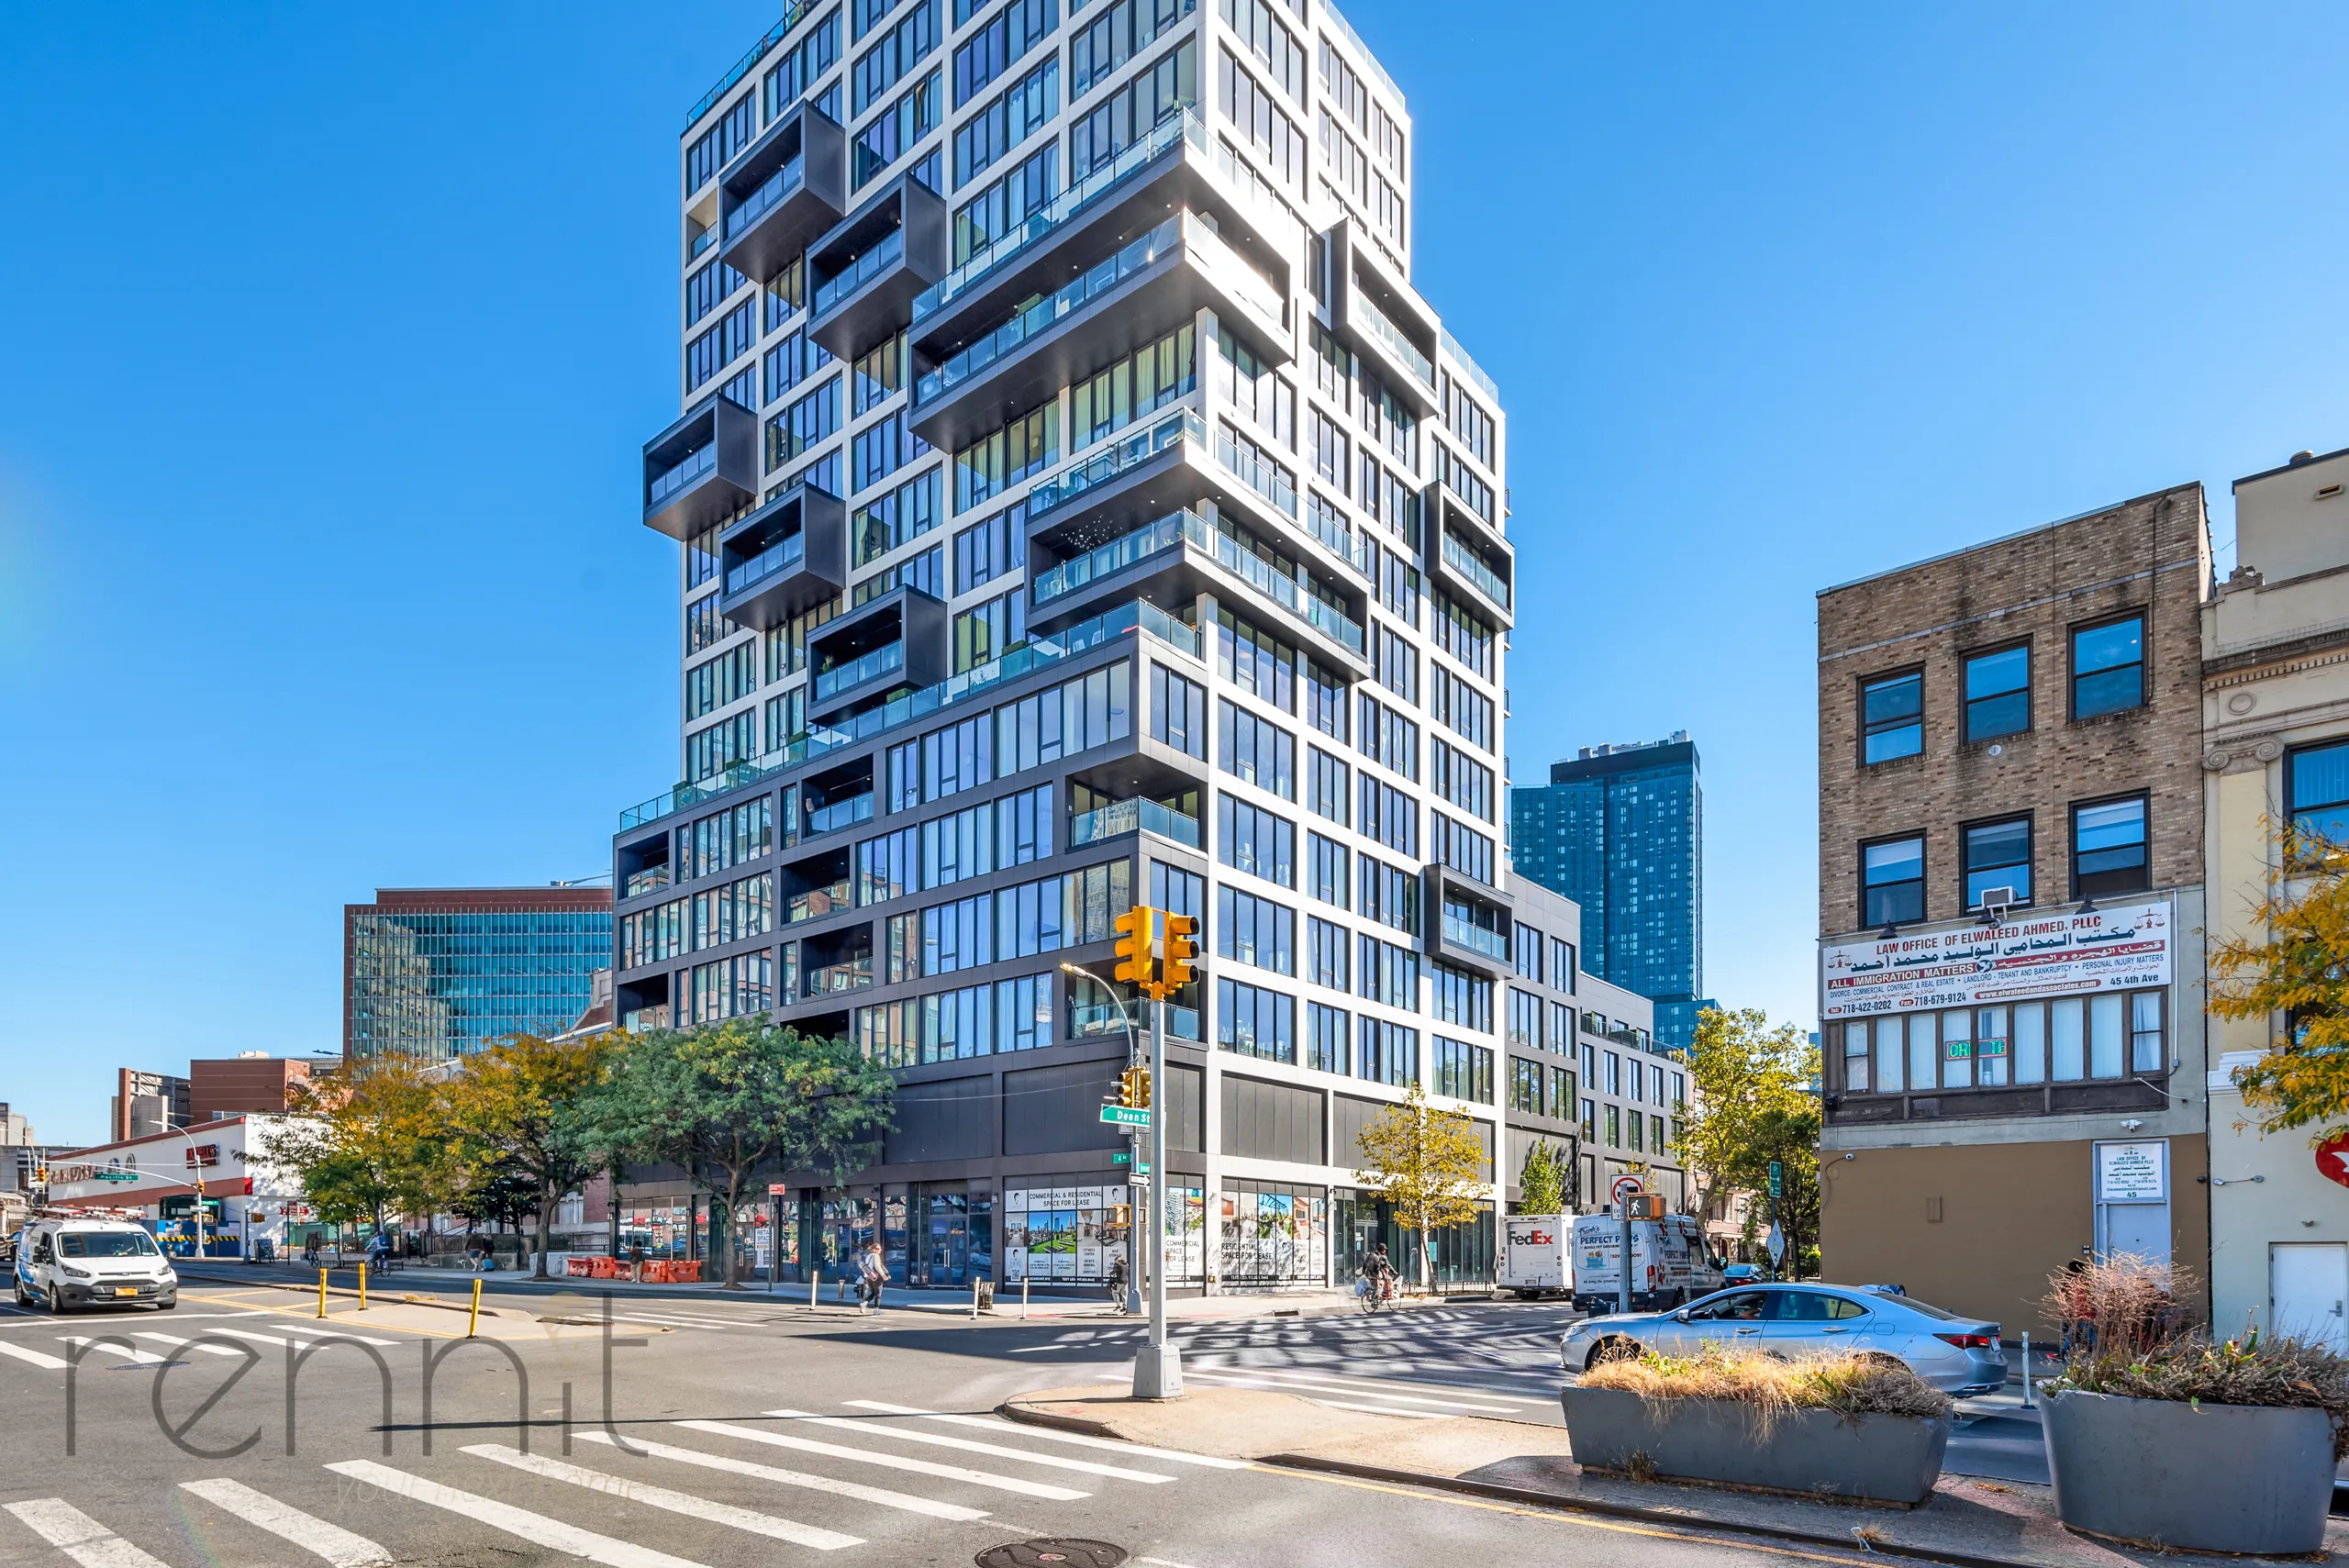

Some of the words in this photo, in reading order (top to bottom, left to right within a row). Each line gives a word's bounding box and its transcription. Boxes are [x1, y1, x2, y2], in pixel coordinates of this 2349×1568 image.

[1876, 943, 1898, 955] LAW
[1902, 938, 1938, 953] OFFICE
[1944, 934, 1957, 946] OF
[1961, 925, 2019, 944] ELWALEED
[2022, 920, 2068, 937] AHMED,
[2072, 916, 2101, 931] PLLC
[2076, 927, 2136, 947] مكتب
[1894, 951, 1939, 967] محمد
[1943, 942, 1999, 963] الوليد
[1851, 954, 1890, 972] أحمد
[1831, 979, 1851, 989] ALL
[1853, 970, 1920, 986] IMMIGRATION
[1923, 963, 1974, 978] MATTERS
[1853, 986, 1884, 996] COMMERCIAL
[1887, 984, 1913, 992] CONTRACT
[1920, 980, 1935, 988] REAL
[1936, 978, 1954, 986] ESTATE
[1963, 973, 1993, 984] LANDLORD
[1998, 970, 2020, 980] TENANT
[2021, 968, 2032, 977] AND
[2033, 963, 2072, 976] BANKRUPTCY
[2082, 960, 2113, 970] PERSONAL
[2114, 957, 2135, 967] INJURY
[2136, 954, 2164, 964] MATTERS
[2110, 977, 2121, 985] 45
[2123, 975, 2139, 984] 4th
[2141, 973, 2159, 983] Ave
[1978, 980, 2097, 1000] www.elwaleedandassociates.com
[1842, 1000, 1892, 1014] 718-422-0202
[1914, 992, 1966, 1006] 718-679-9124
[1117, 1110, 1140, 1122] Dean
[1507, 1230, 1554, 1246] FedEx
[1580, 1236, 1613, 1244] PERFECT
[1615, 1234, 1639, 1242] PS
[1221, 1242, 1257, 1251] RESIDENTIAL
[1221, 1251, 1240, 1260] SPACE
[1241, 1251, 1252, 1260] FOR
